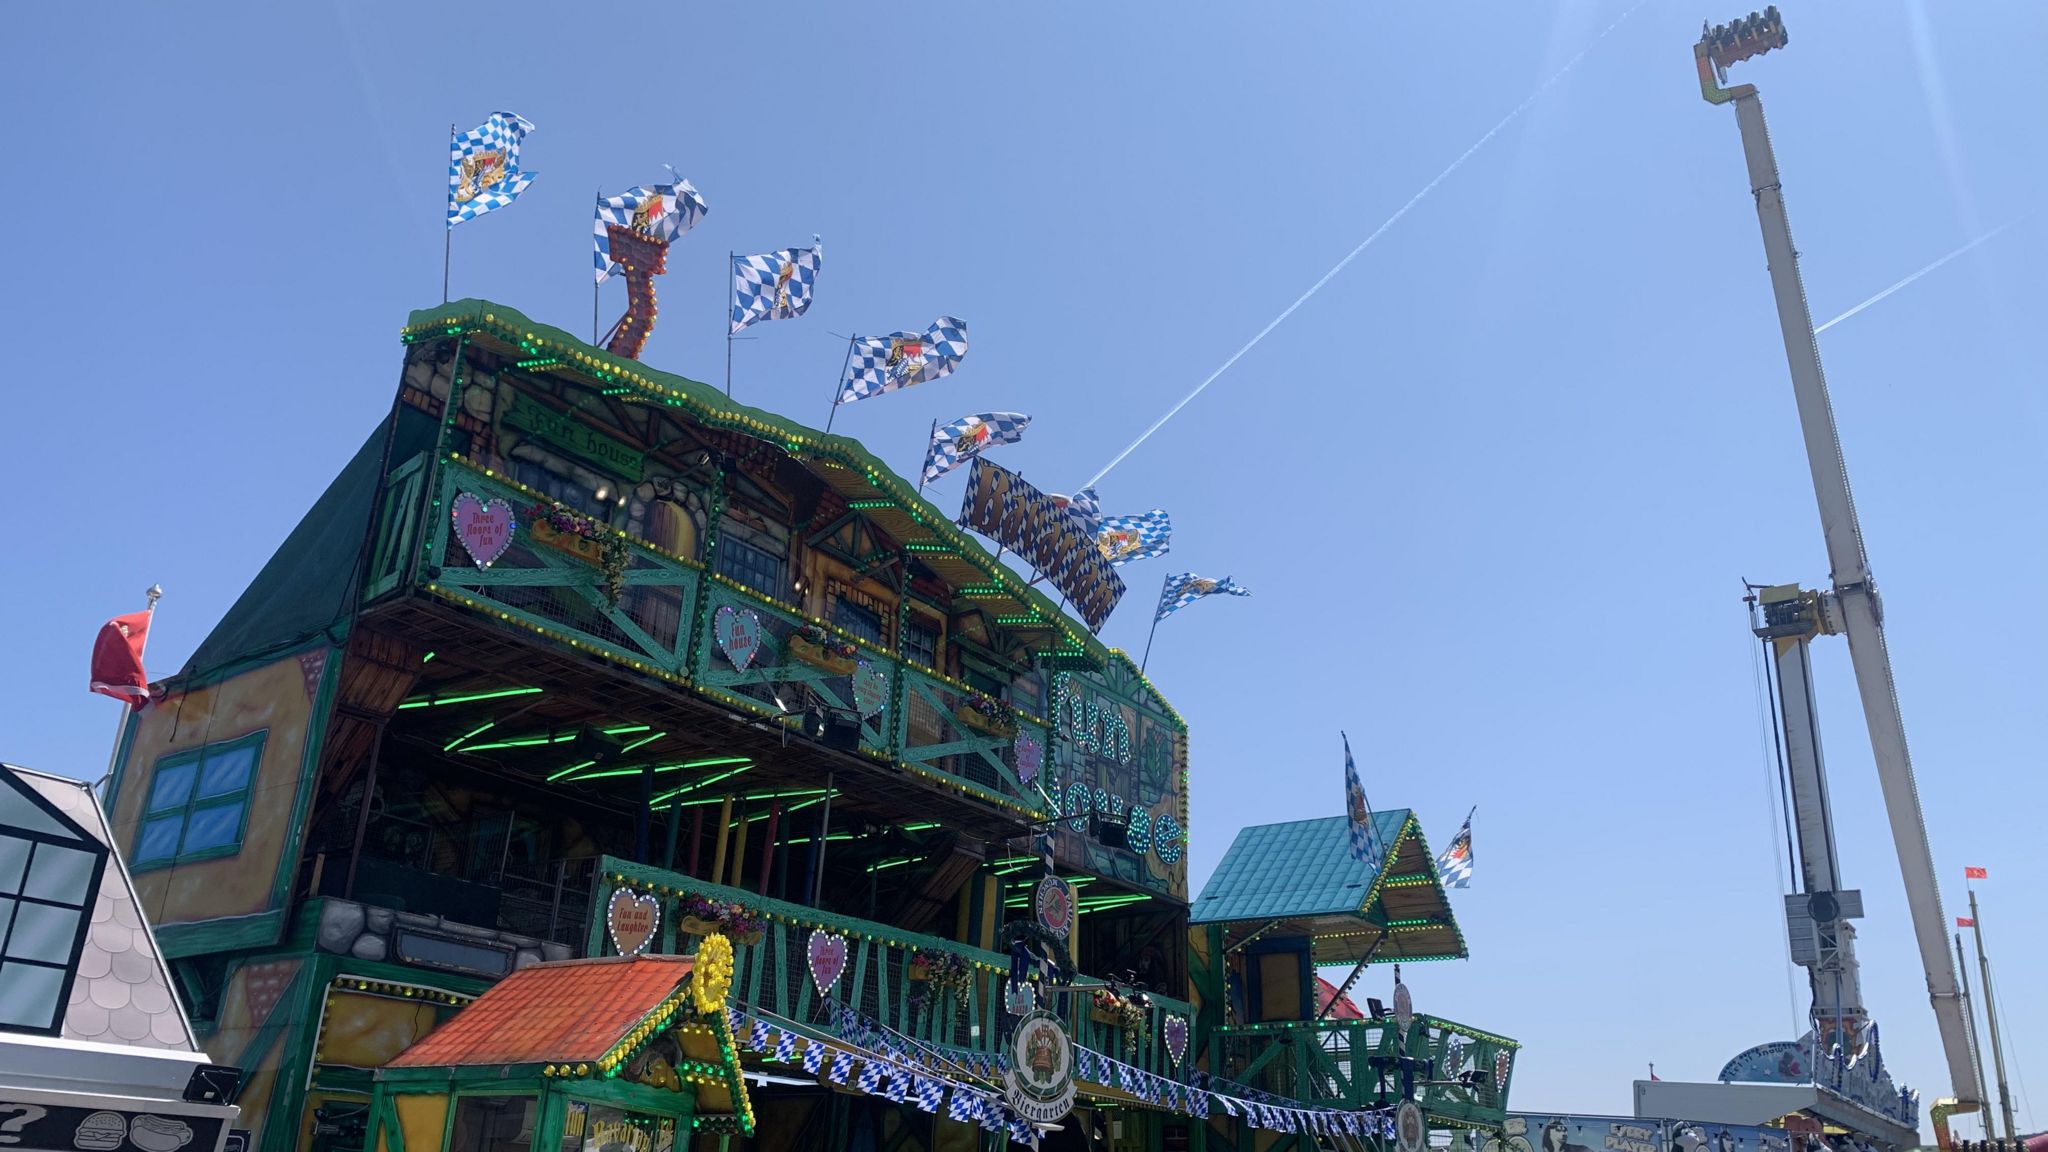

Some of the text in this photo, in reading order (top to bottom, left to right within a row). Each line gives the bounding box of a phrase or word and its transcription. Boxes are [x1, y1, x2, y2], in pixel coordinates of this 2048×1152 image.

[472, 512, 495, 525] Three
[467, 523, 504, 537] floors of
[479, 535, 493, 548] fun
[729, 636, 752, 650] house
[633, 910, 649, 921] and
[1011, 1089, 1070, 1121] Biergarten
